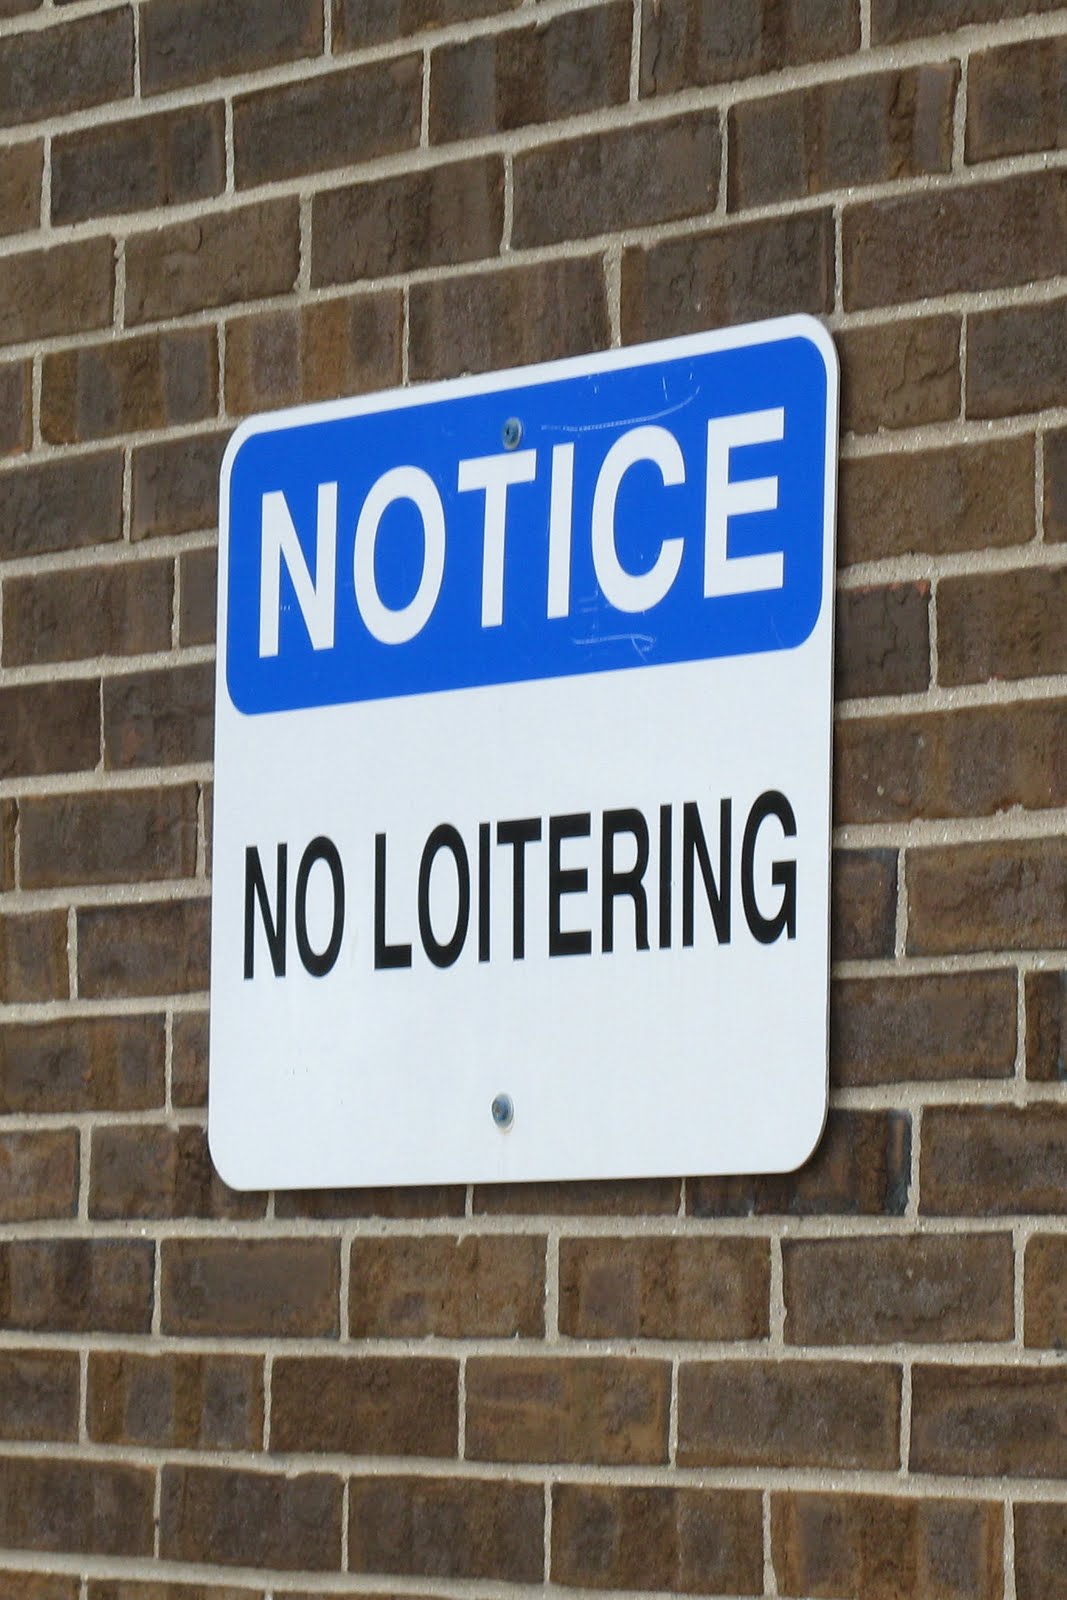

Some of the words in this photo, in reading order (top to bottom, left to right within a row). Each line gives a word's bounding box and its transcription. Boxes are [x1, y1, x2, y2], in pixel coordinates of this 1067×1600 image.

[259, 407, 785, 657] NOTICE
[243, 836, 345, 980] NO
[374, 790, 797, 970] LOITERING
